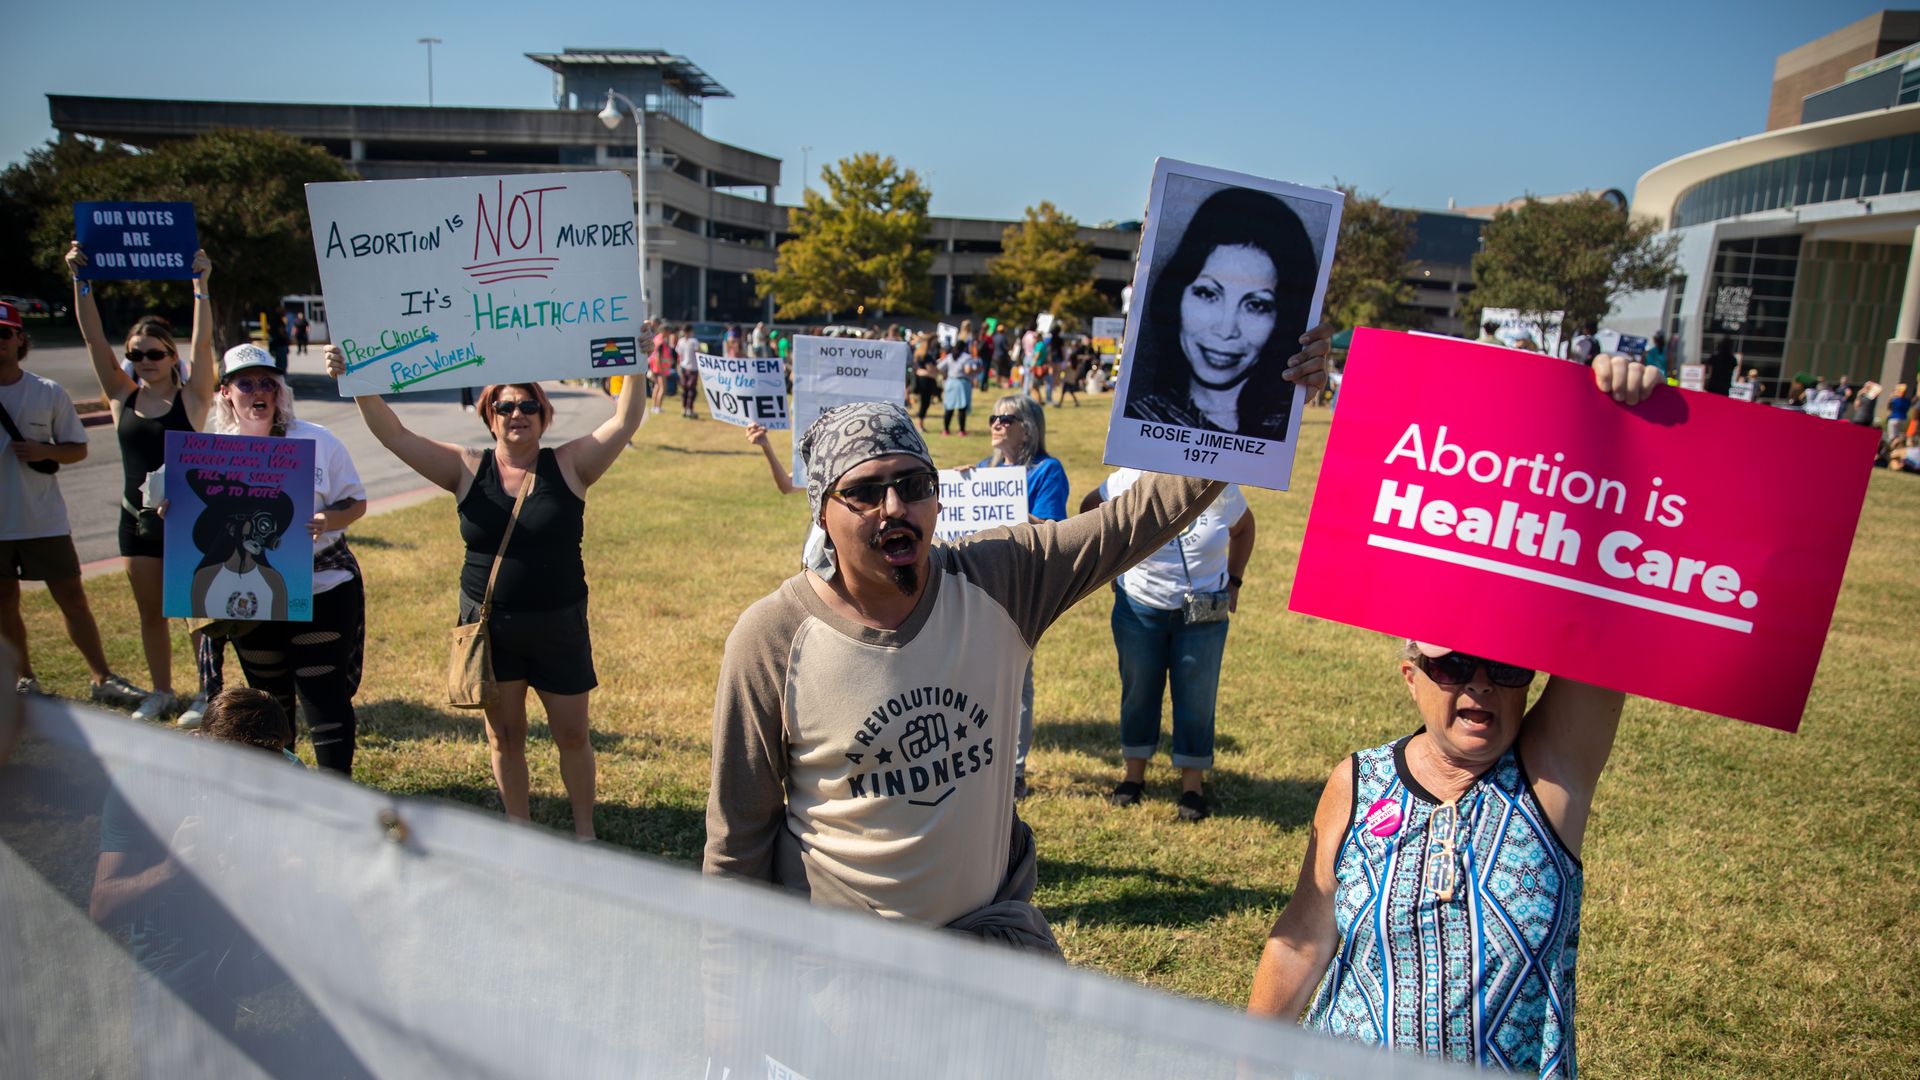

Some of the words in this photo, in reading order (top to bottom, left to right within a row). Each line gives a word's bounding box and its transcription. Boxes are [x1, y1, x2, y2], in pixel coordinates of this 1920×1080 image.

[93, 210, 123, 225] OUR
[126, 210, 175, 226] VOTES
[326, 221, 441, 259] ABORTION
[474, 179, 567, 261] NOT
[556, 220, 634, 248] MURDER
[123, 232, 151, 246] ARE
[95, 253, 126, 268] OUR
[129, 253, 184, 267] VOICES
[473, 292, 629, 331] HEALTHCARE
[820, 346, 843, 357] NOT
[850, 348, 883, 360] YOUR
[699, 355, 748, 373] SNATCH
[836, 366, 869, 378] BODY
[717, 372, 732, 391] by
[735, 373, 756, 388] the
[706, 387, 786, 419] VOTE!
[1140, 423, 1191, 444] ROSIE
[1195, 433, 1266, 455] JIMENEZ
[1183, 448, 1219, 465] 1977
[1384, 423, 1627, 515] Abortion
[1644, 477, 1687, 528] is
[228, 486, 244, 497] TO
[940, 482, 965, 498] THE
[972, 480, 1024, 497] CHURCH
[941, 506, 965, 521] THE
[972, 504, 1015, 521] STATE
[1373, 478, 1582, 566] Health
[1597, 530, 1758, 609] Care.
[854, 687, 968, 747] REVOLUTION
[969, 703, 989, 729] IN
[845, 752, 864, 765] A
[848, 738, 993, 799] KINDNESS
